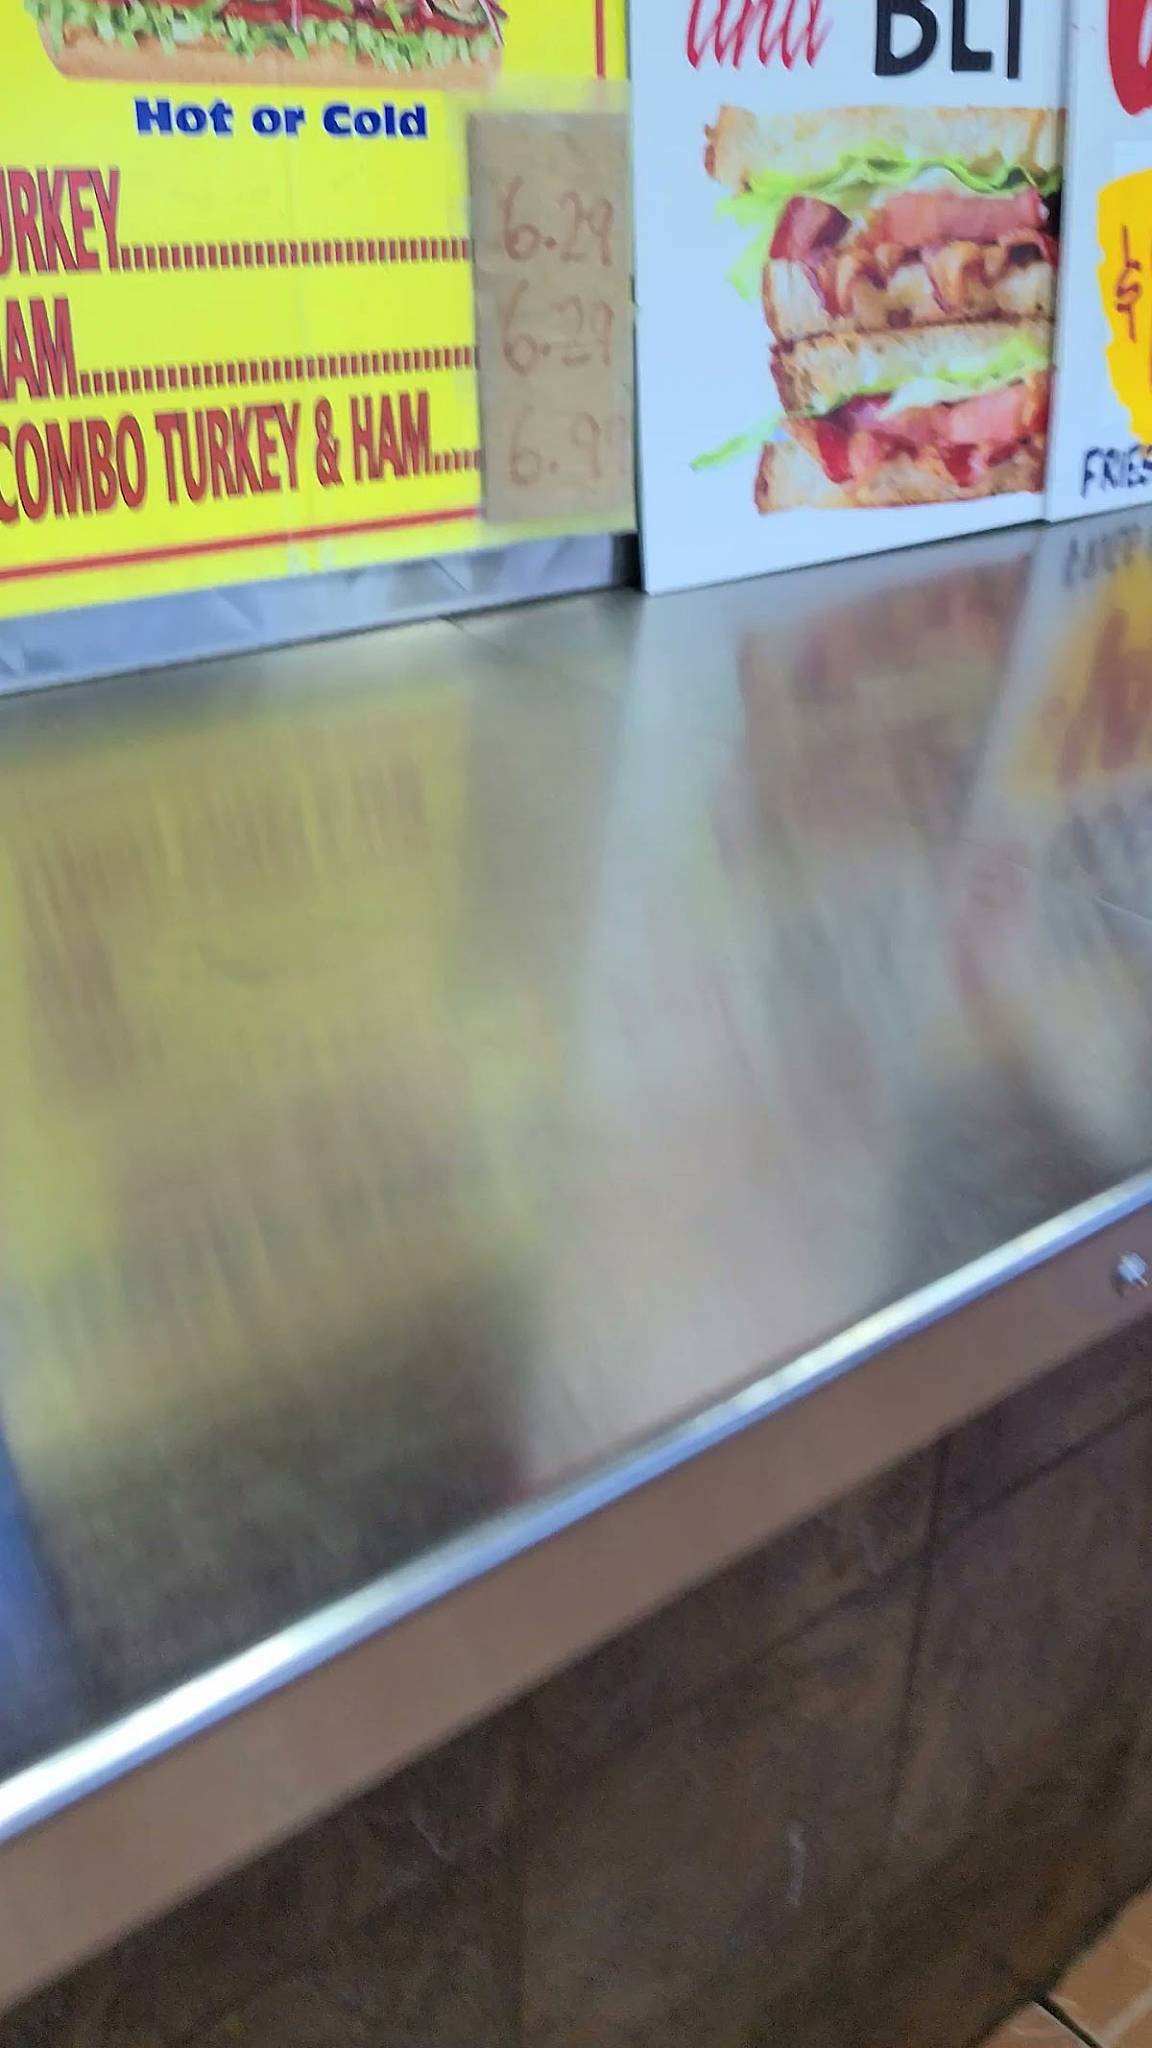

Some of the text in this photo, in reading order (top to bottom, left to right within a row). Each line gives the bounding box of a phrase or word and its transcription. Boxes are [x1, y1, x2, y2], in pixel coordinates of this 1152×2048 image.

[134, 97, 429, 138] Hot or Cold
[0, 296, 79, 400] AM
[154, 401, 302, 505] TURKEY
[314, 394, 343, 489] &
[349, 389, 434, 483] HAM
